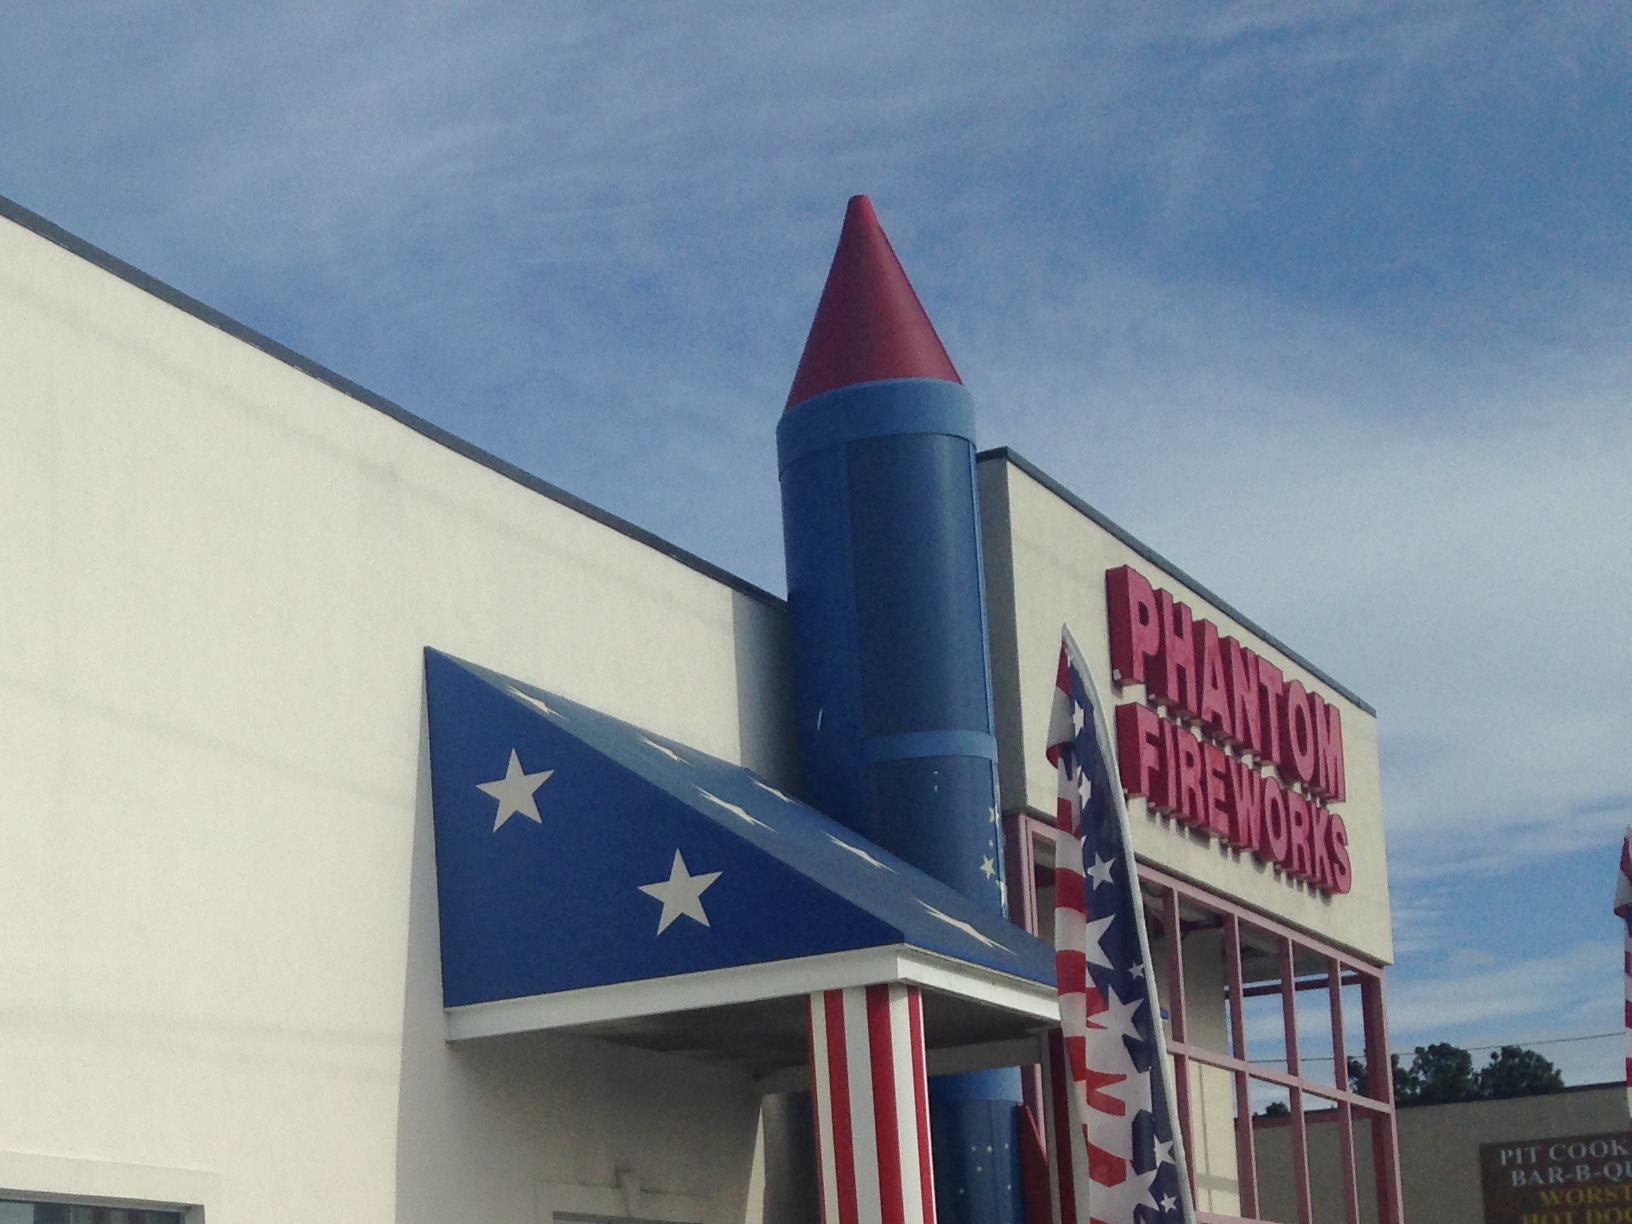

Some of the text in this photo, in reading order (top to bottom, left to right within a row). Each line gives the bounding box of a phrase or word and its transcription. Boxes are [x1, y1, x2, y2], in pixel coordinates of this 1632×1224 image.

[1106, 564, 1347, 803] PHANTOM
[1115, 702, 1352, 895] FIREWORKS
[1499, 1147, 1542, 1166] PIT
